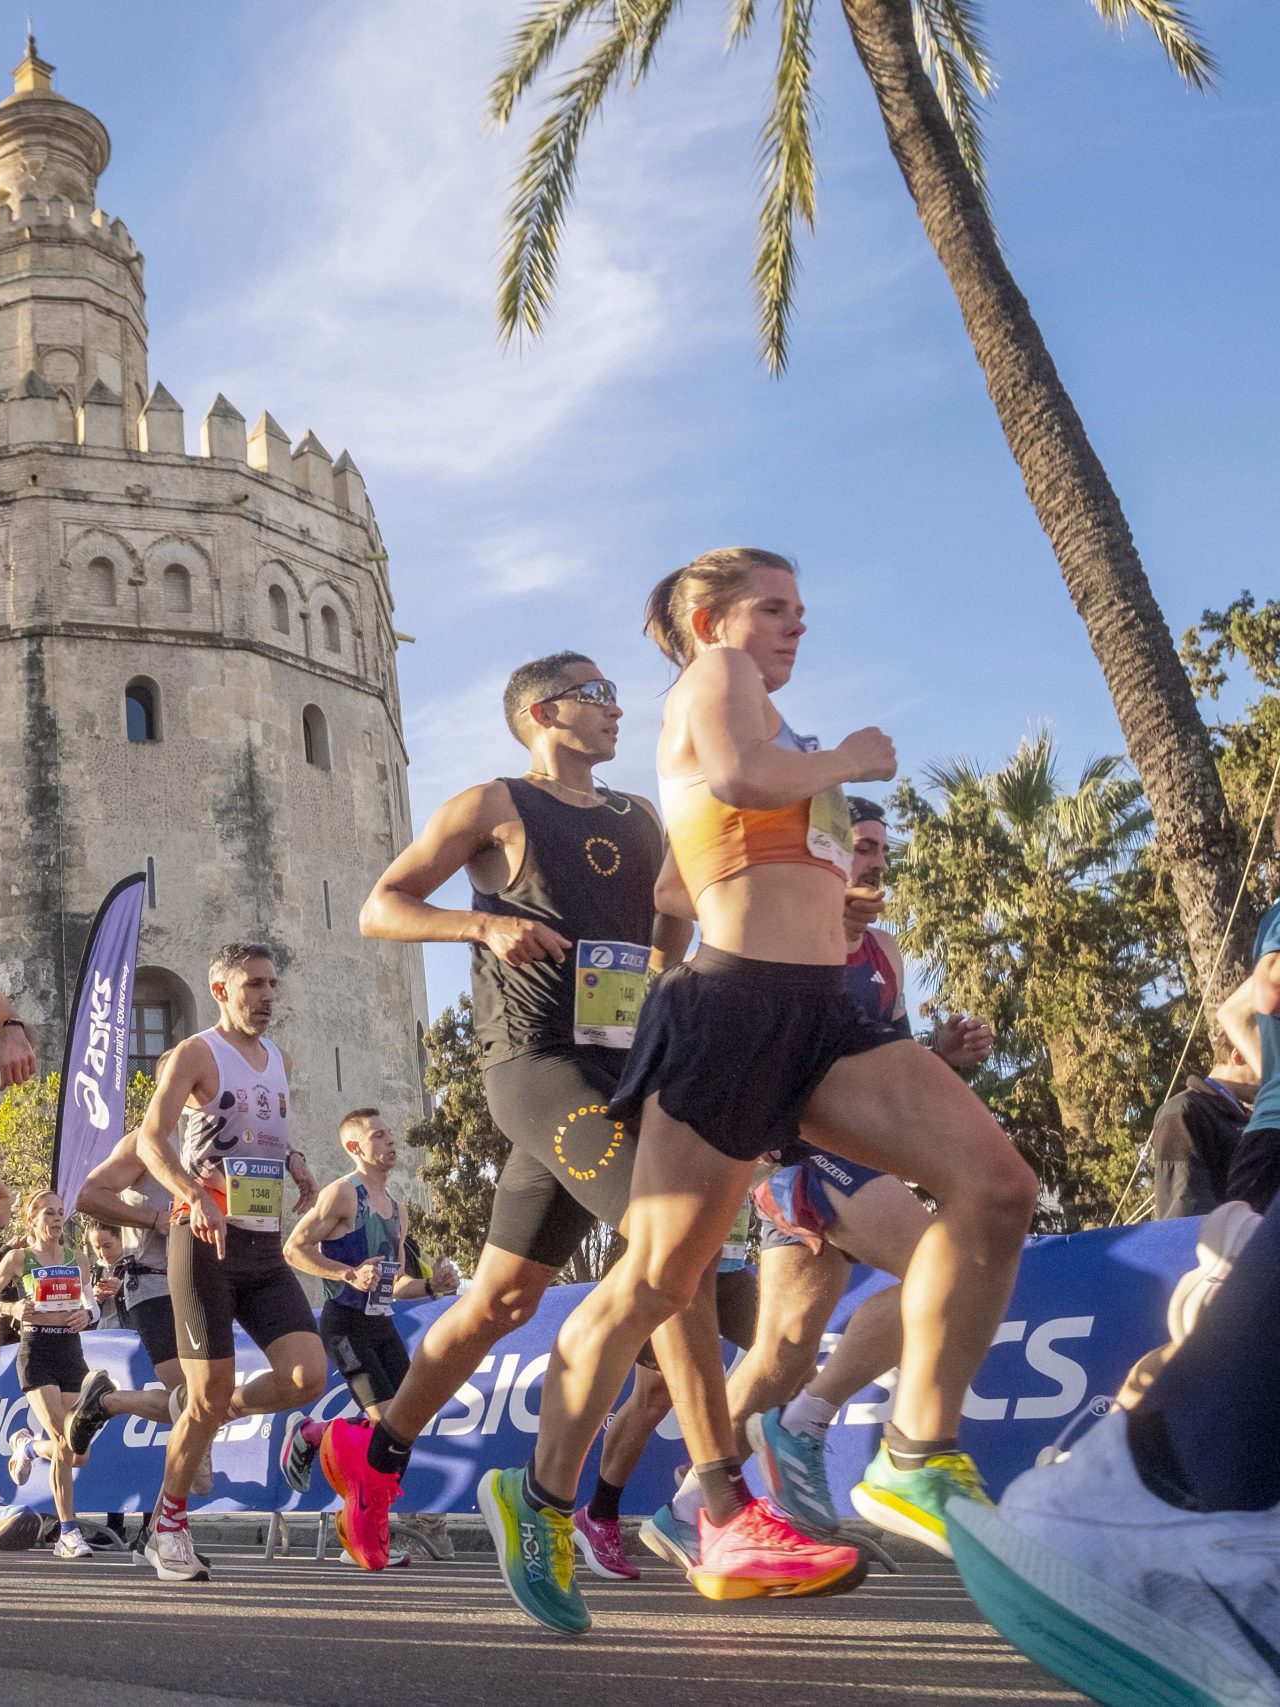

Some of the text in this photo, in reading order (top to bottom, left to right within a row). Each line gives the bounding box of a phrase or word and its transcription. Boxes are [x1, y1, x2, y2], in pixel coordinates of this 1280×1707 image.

[83, 970, 112, 1077] asics
[116, 992, 127, 1025] sound
[114, 1025, 127, 1055] mind,
[115, 1054, 123, 1092] sound
[250, 1164, 280, 1175] ZURICH
[810, 1154, 854, 1186] ADIZERO
[251, 1187, 270, 1199] 1348
[50, 1268, 75, 1276] ZURICH
[520, 1521, 545, 1585] HOKA
